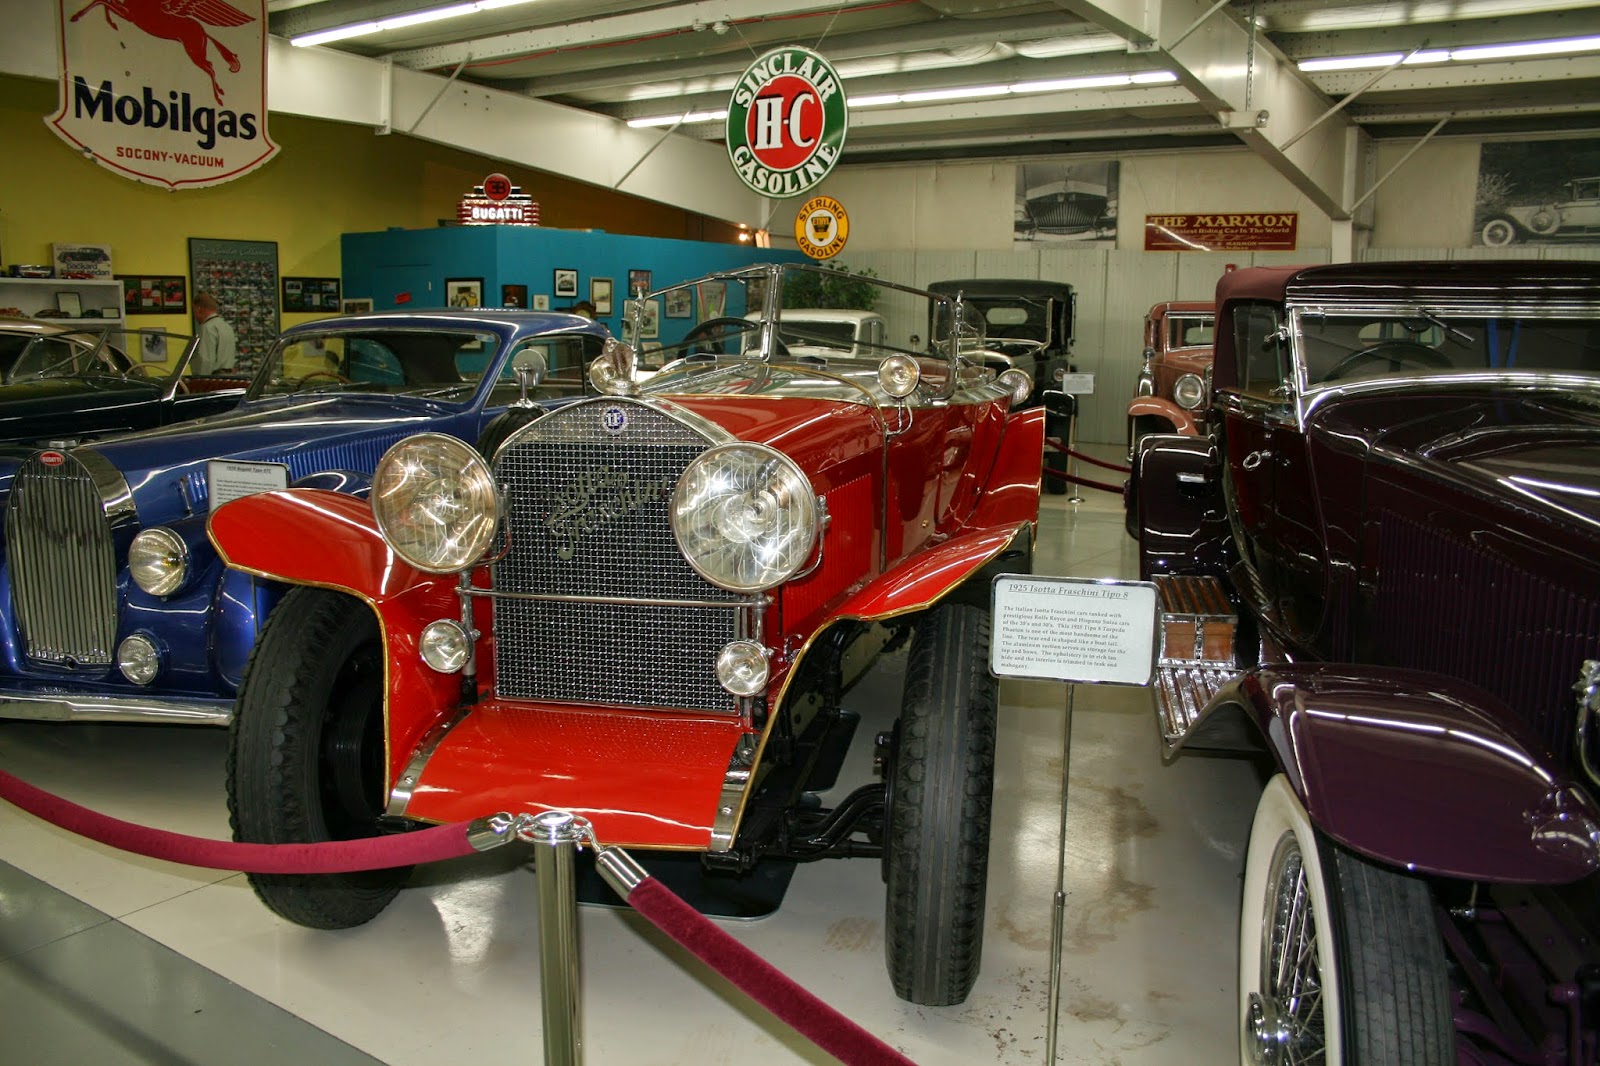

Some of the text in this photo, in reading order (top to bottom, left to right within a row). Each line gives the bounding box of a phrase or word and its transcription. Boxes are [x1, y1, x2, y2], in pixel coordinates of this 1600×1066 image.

[736, 53, 836, 108] SINCLAIR
[74, 76, 257, 150] Mobilgas
[116, 146, 224, 168] SOCONY-VACUUM
[734, 142, 837, 194] GASOLINE
[472, 207, 522, 220] BUGATTI
[800, 198, 844, 222] STERLING
[1151, 215, 1294, 227] THE MARMON
[800, 235, 844, 257] GASOLINE
[1008, 584, 1028, 592] 1925
[1030, 585, 1056, 594] Isotta
[1058, 586, 1098, 596] Fraschini
[1101, 589, 1121, 599] Tipo
